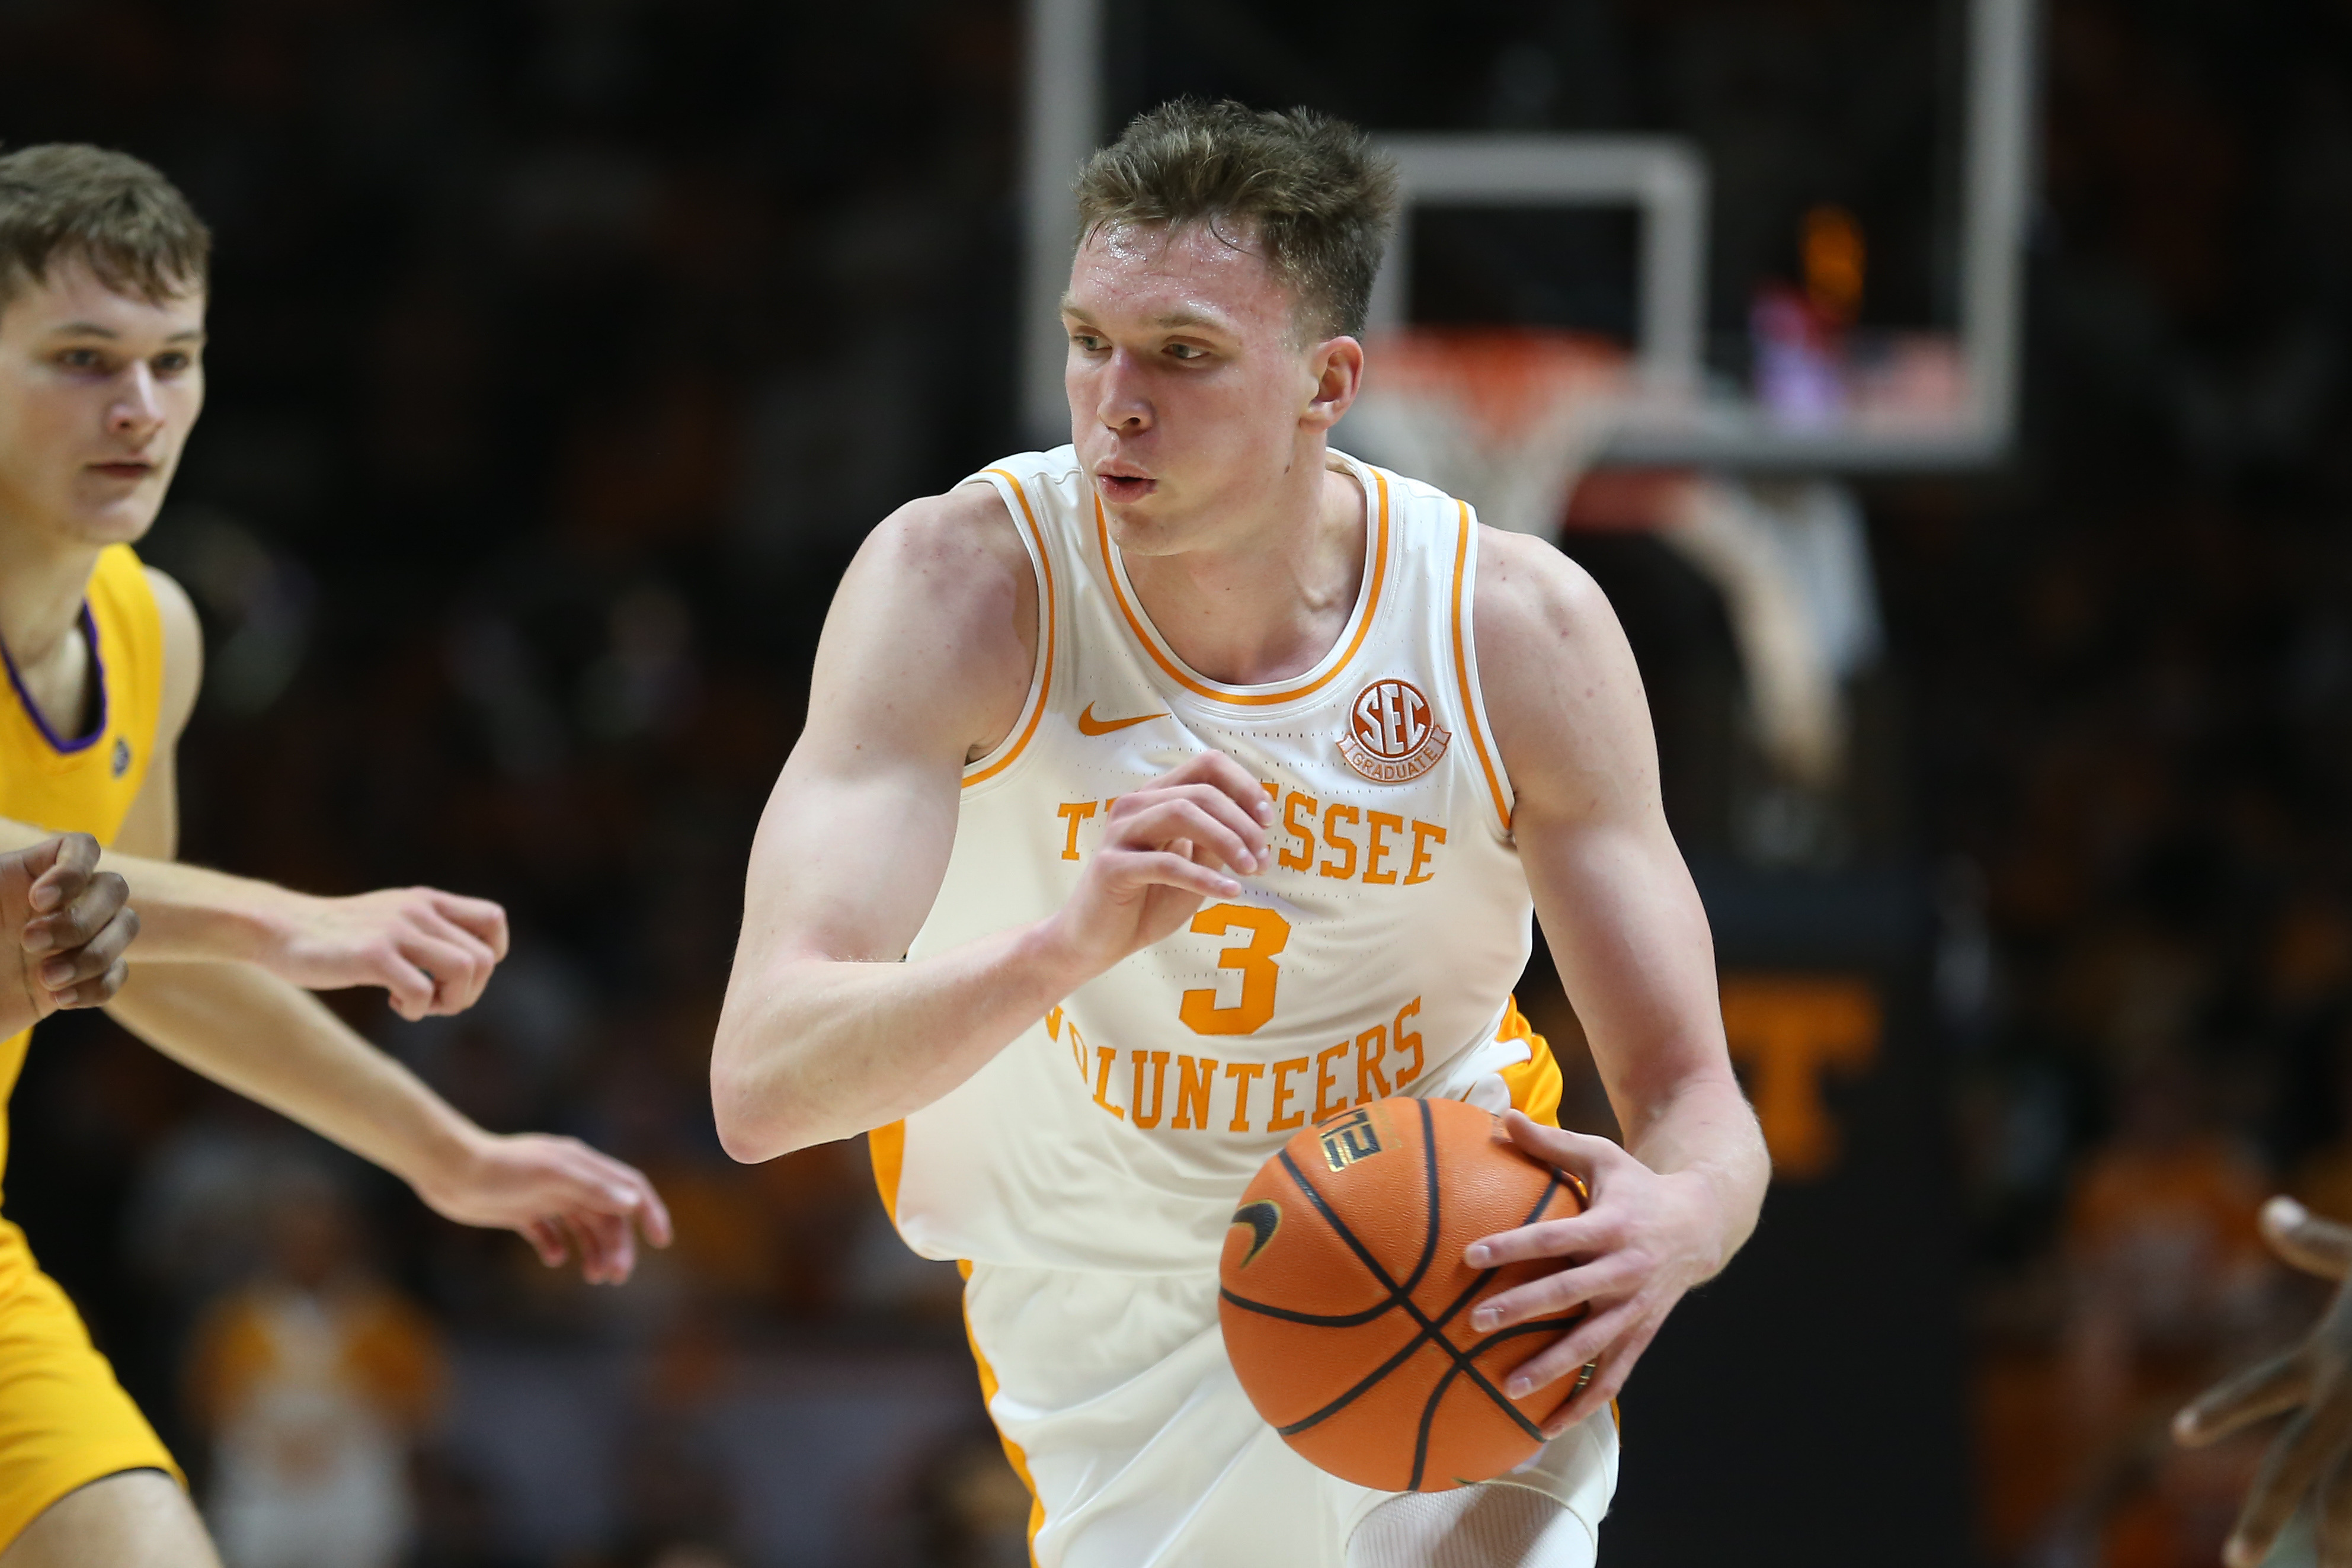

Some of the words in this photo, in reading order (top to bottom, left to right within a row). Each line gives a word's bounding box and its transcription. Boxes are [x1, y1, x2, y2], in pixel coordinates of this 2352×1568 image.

[1353, 747, 1438, 779] GRADUATE
[1356, 684, 1426, 754] SEC
[1057, 782, 1447, 885] TSSEE
[1179, 903, 1291, 1035] 3
[1719, 977, 1884, 1178] T
